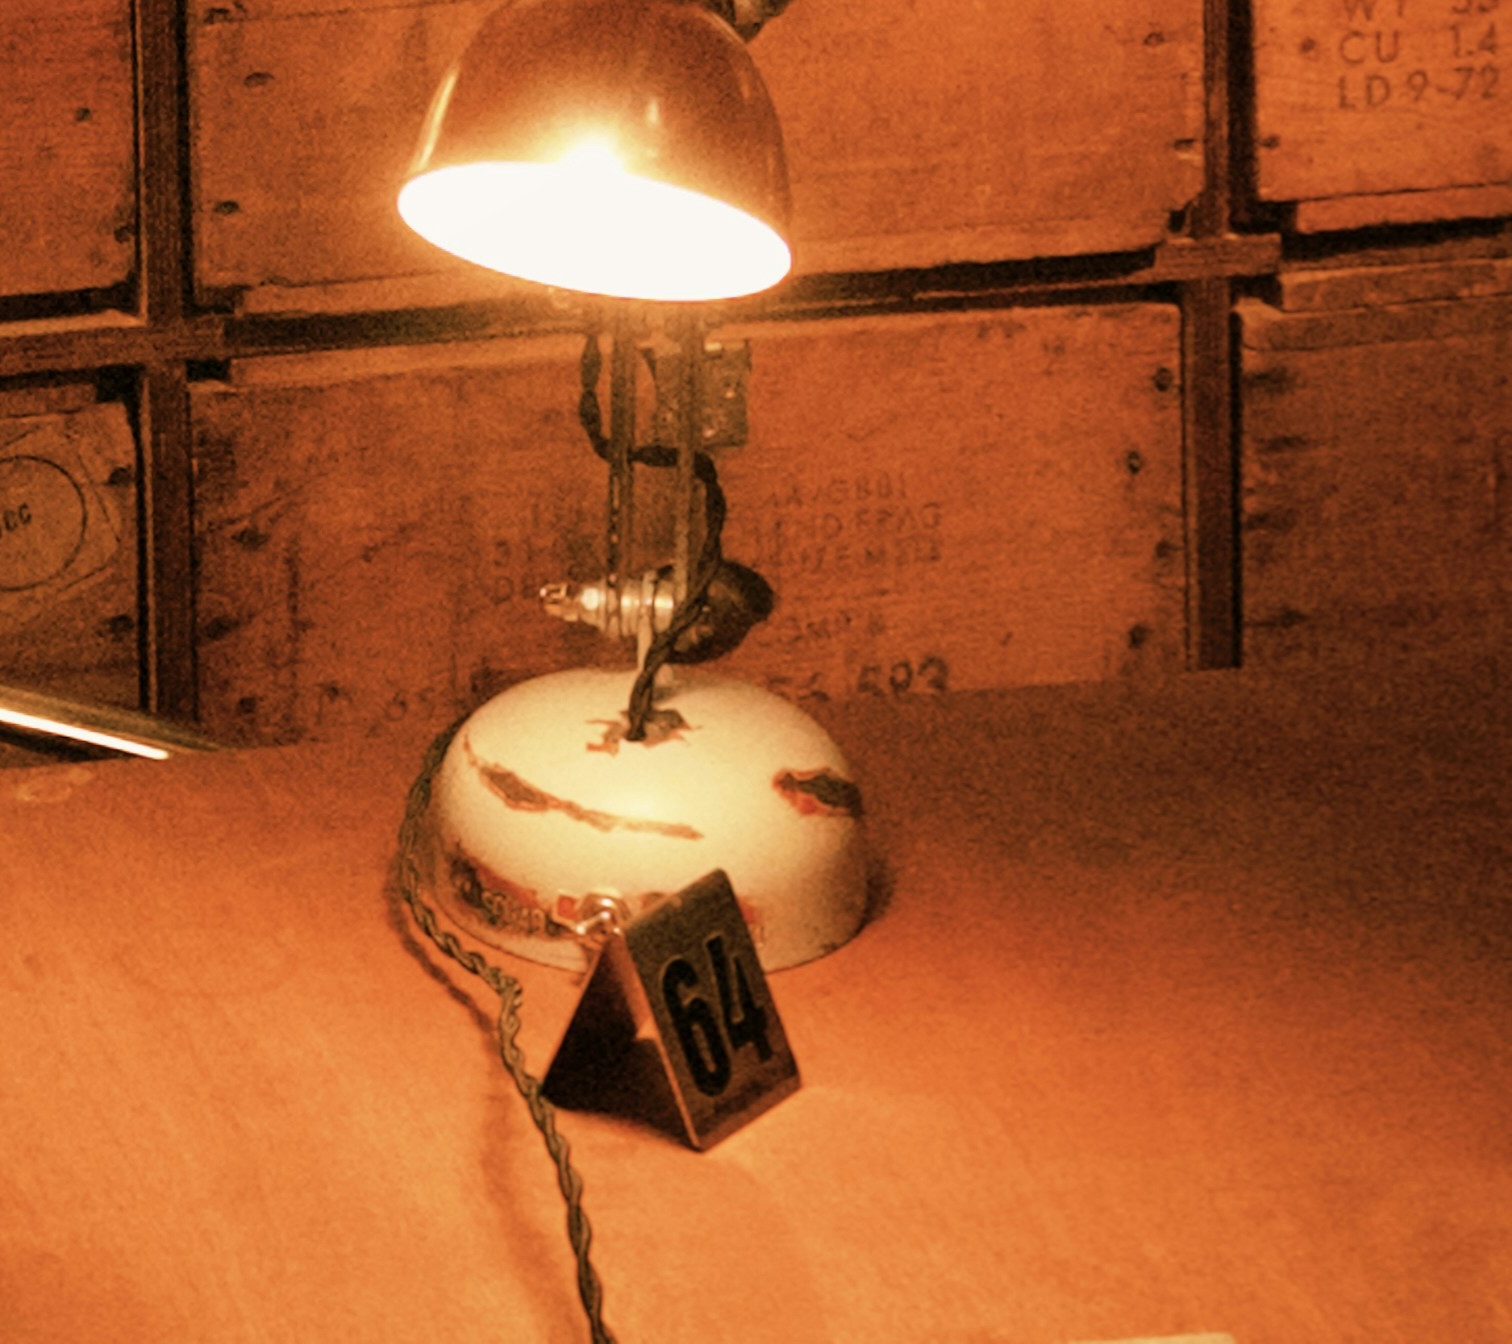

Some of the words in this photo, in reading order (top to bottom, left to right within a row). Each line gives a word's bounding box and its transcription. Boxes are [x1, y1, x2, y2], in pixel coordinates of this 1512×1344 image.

[1339, 30, 1400, 64] CU
[1338, 74, 1391, 110] LD
[661, 931, 774, 1097] 64
